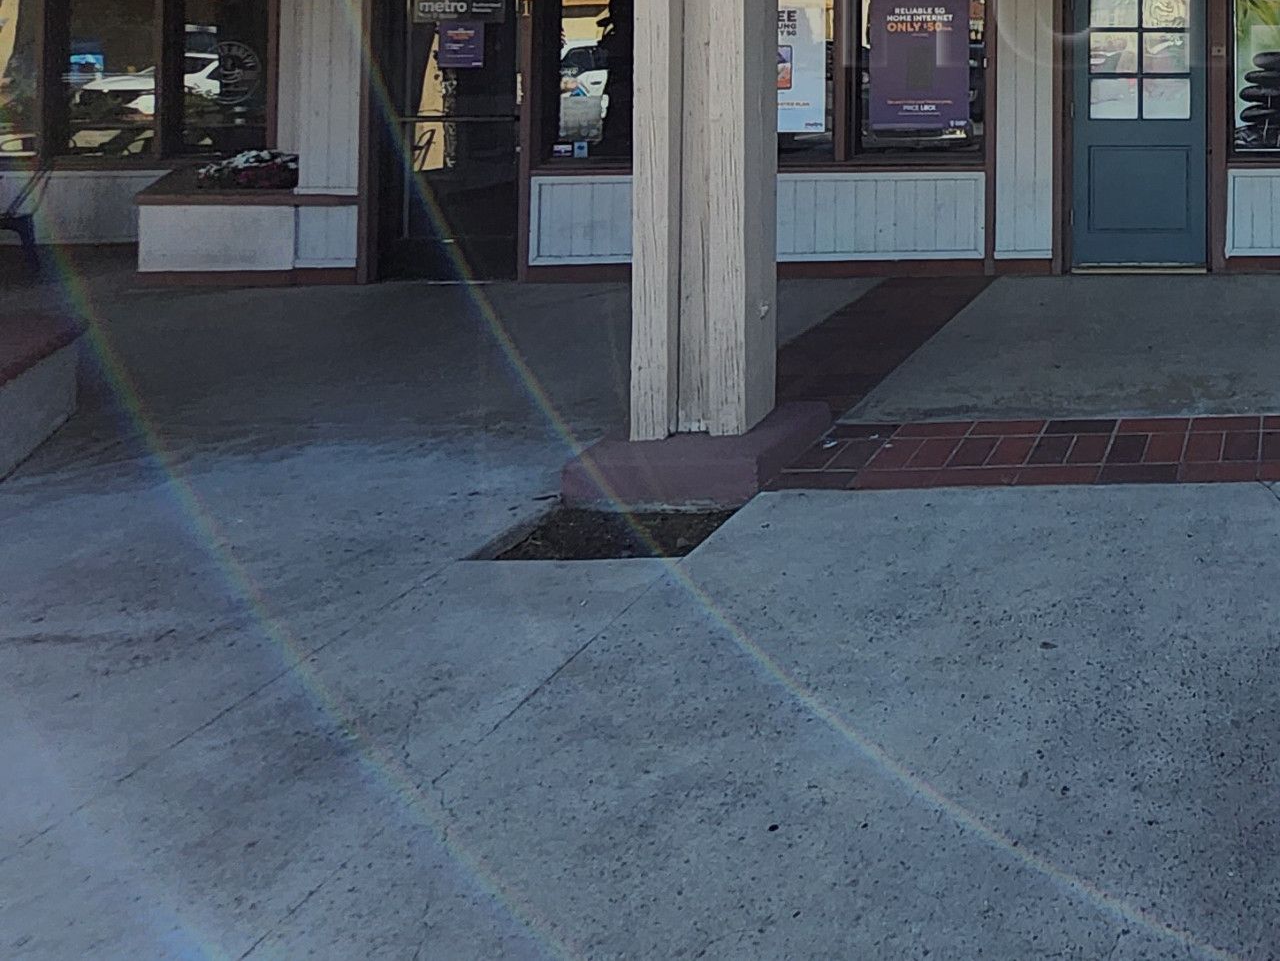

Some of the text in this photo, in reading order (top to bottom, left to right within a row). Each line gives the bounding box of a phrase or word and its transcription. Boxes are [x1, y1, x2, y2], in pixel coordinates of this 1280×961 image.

[419, 0, 467, 13] metro
[913, 14, 953, 22] INTERNET
[887, 22, 921, 32] ONLY
